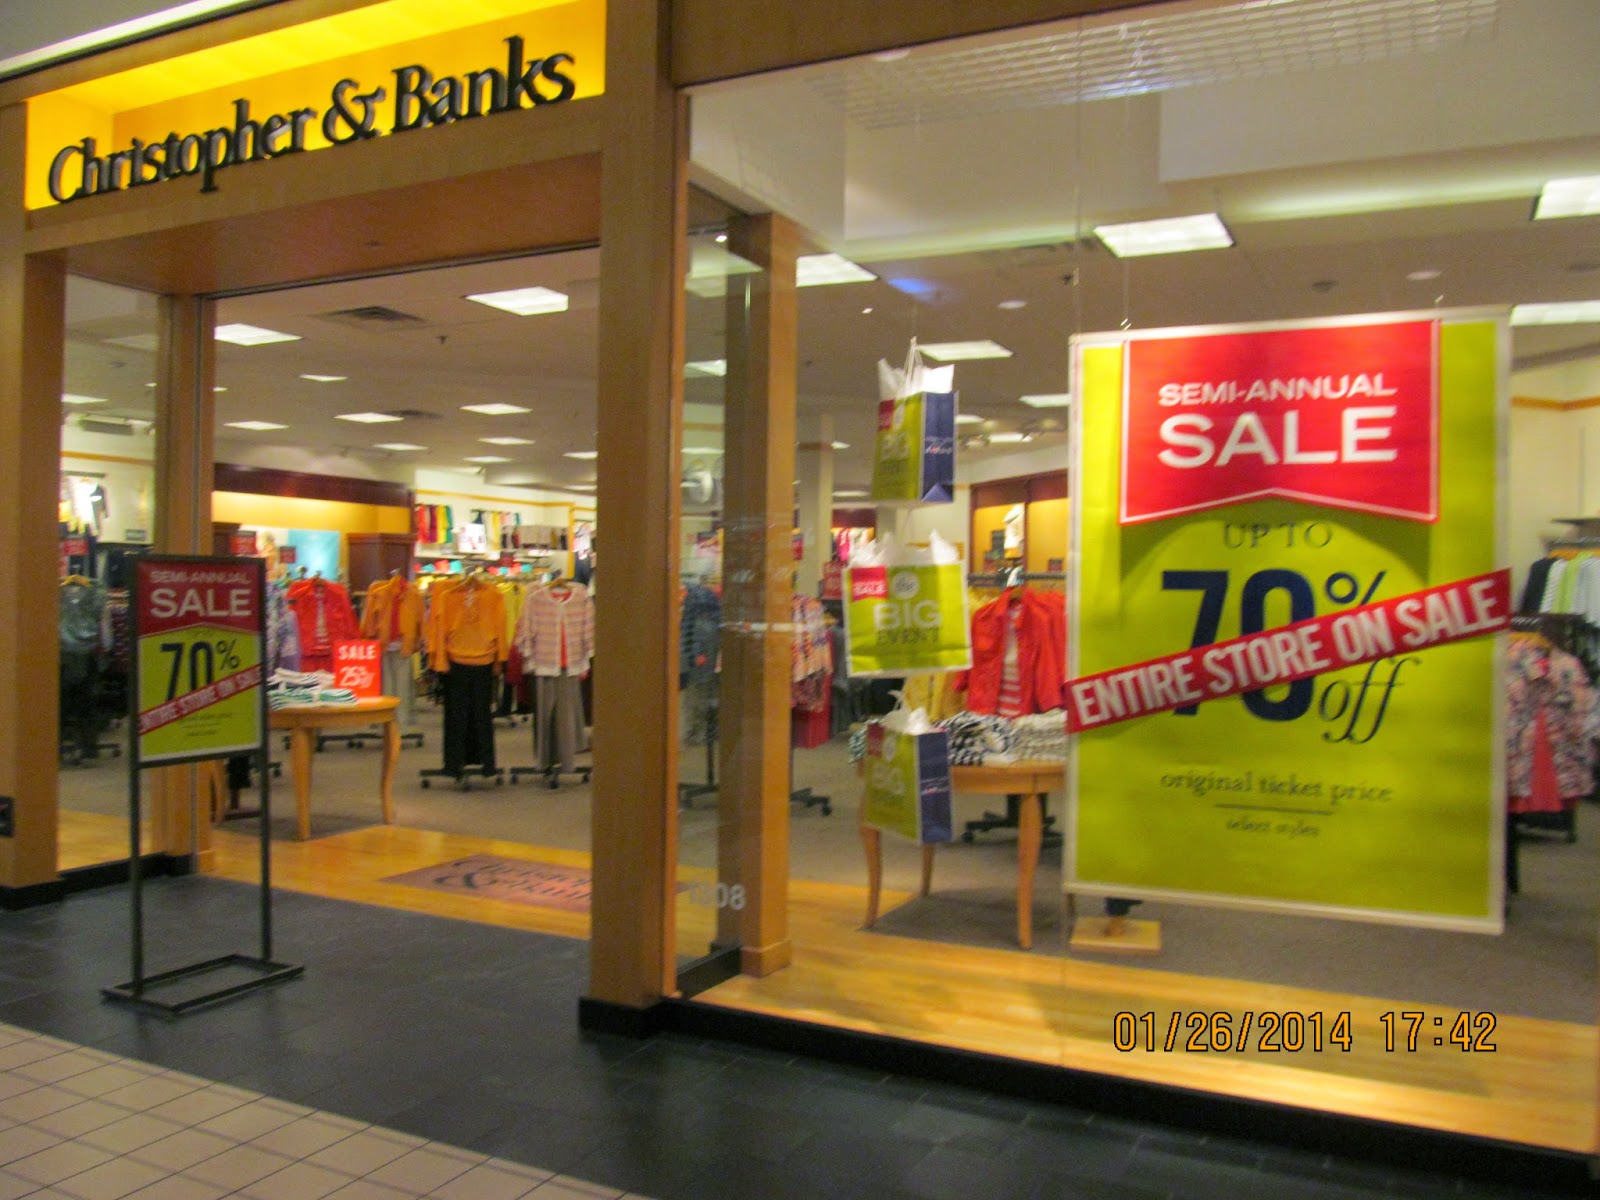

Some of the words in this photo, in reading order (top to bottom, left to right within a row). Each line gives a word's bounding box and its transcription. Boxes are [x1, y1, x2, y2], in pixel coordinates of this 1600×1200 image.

[48, 98, 317, 203] Christopher
[322, 78, 386, 145] &
[389, 34, 577, 133] Banks
[1158, 373, 1398, 407] SEMI-ANNUAL
[1158, 405, 1398, 468] SALE
[150, 570, 251, 584] SEMI-ANNUAL
[150, 587, 252, 618] SALE
[873, 599, 945, 630] BIG
[160, 638, 240, 702] 70%
[338, 644, 376, 660] SALE
[1072, 654, 1204, 727] ENTIRE
[1202, 622, 1331, 694] STORE
[1331, 605, 1395, 663] ON
[1394, 578, 1508, 648] SALE
[1318, 655, 1422, 745] off
[1160, 770, 1254, 797] original
[1258, 774, 1323, 796] ticket
[1329, 781, 1393, 807] price
